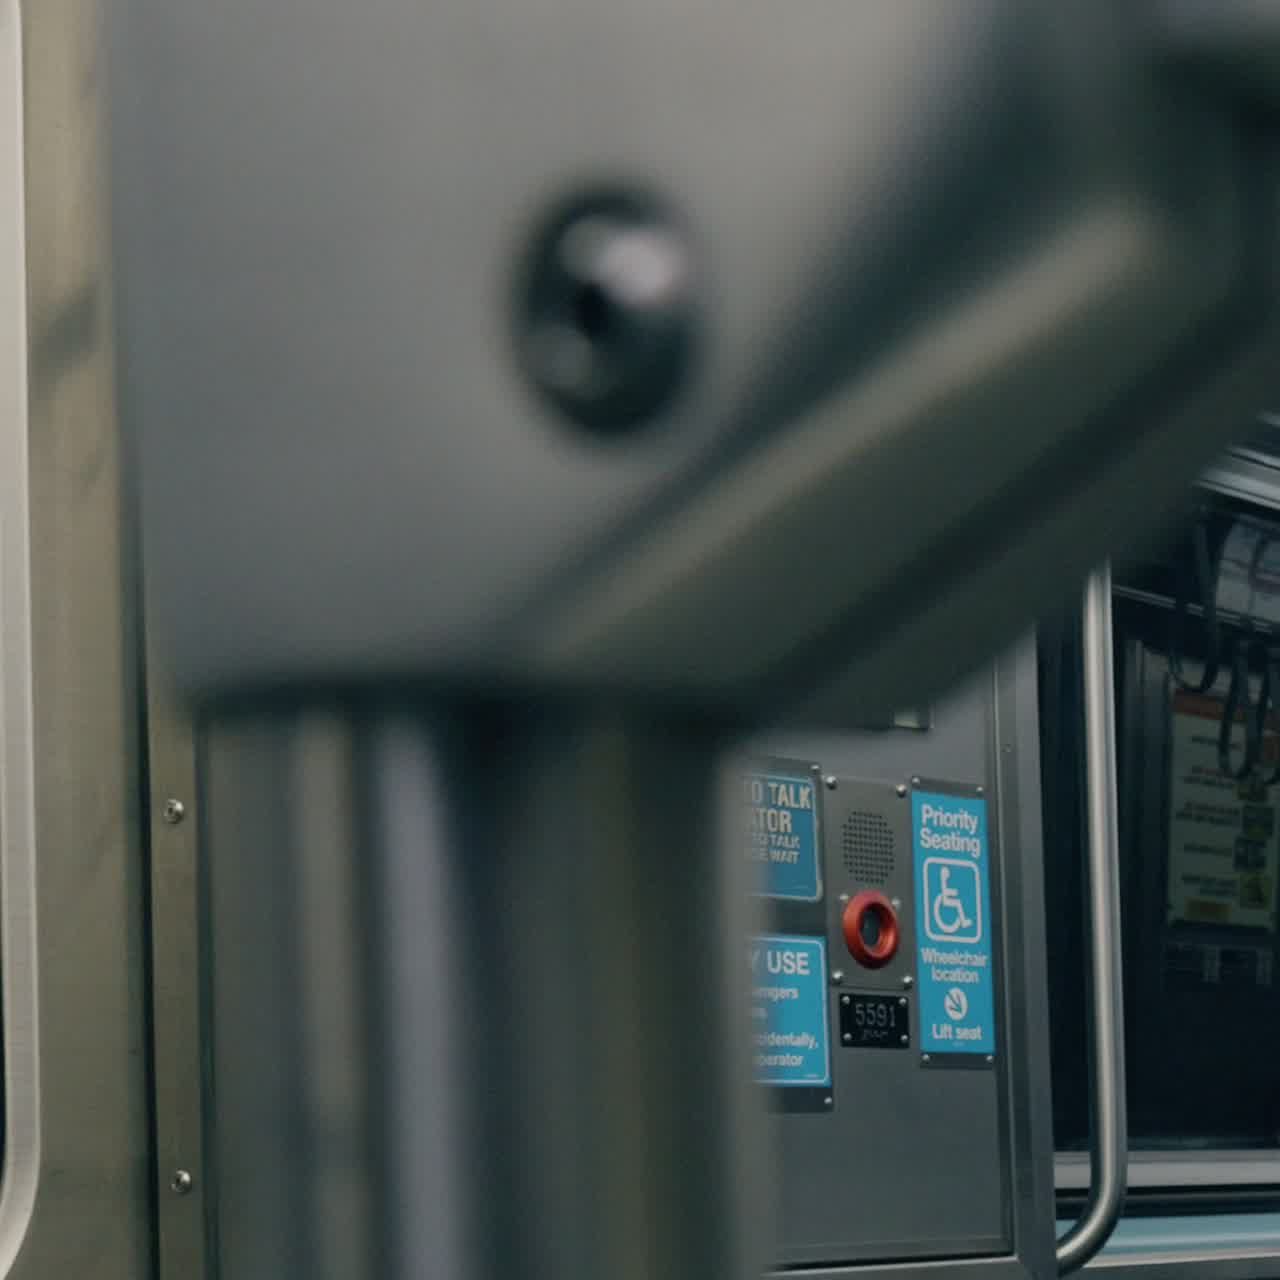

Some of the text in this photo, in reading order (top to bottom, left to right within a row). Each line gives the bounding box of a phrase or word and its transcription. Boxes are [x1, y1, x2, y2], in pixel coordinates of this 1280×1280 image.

[767, 782, 812, 809] TALK
[922, 803, 978, 835] Priority
[768, 833, 801, 849] TALK
[920, 827, 981, 859] Seating
[767, 950, 811, 976] USE
[921, 947, 988, 968] Wheelchair
[931, 965, 979, 984] location
[855, 1003, 897, 1028] 5591
[932, 1023, 983, 1041] Lift seat
